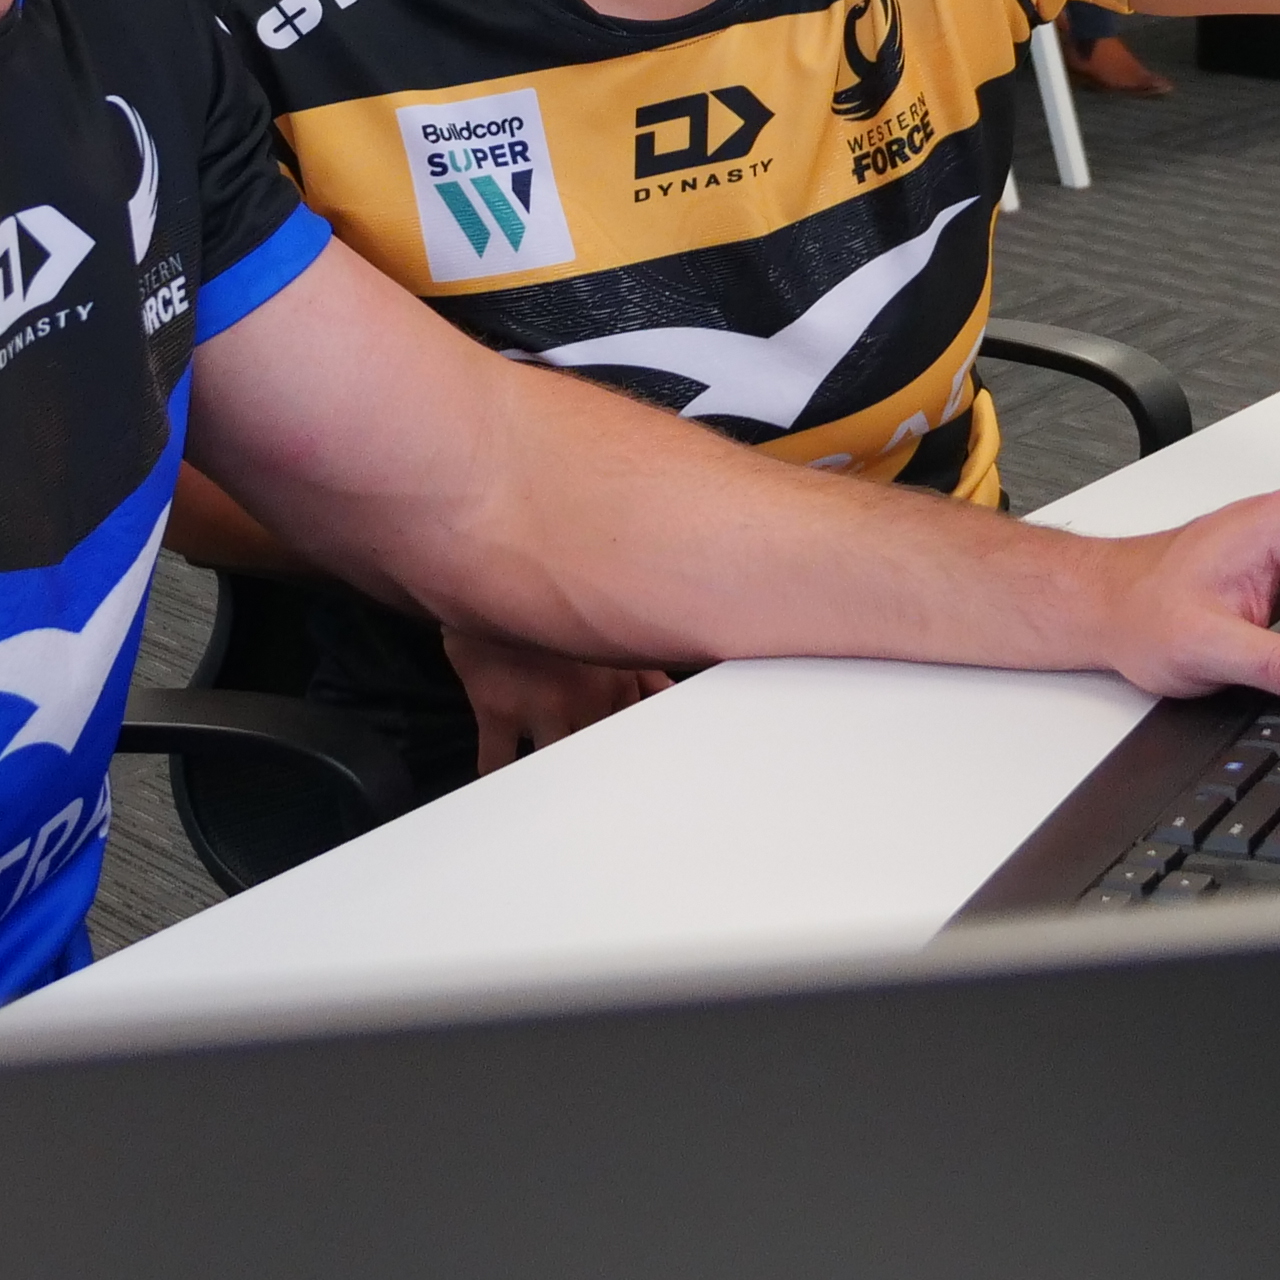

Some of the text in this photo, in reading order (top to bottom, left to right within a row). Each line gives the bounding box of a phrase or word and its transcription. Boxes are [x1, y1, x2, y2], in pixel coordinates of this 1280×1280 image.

[421, 115, 524, 144] Buildcorp
[846, 91, 926, 154] WESTERN
[427, 140, 532, 177] SUPER
[852, 109, 935, 185] FORCE
[634, 158, 774, 203] DYNASTY
[139, 252, 183, 300] STERN
[142, 275, 189, 336] RCE
